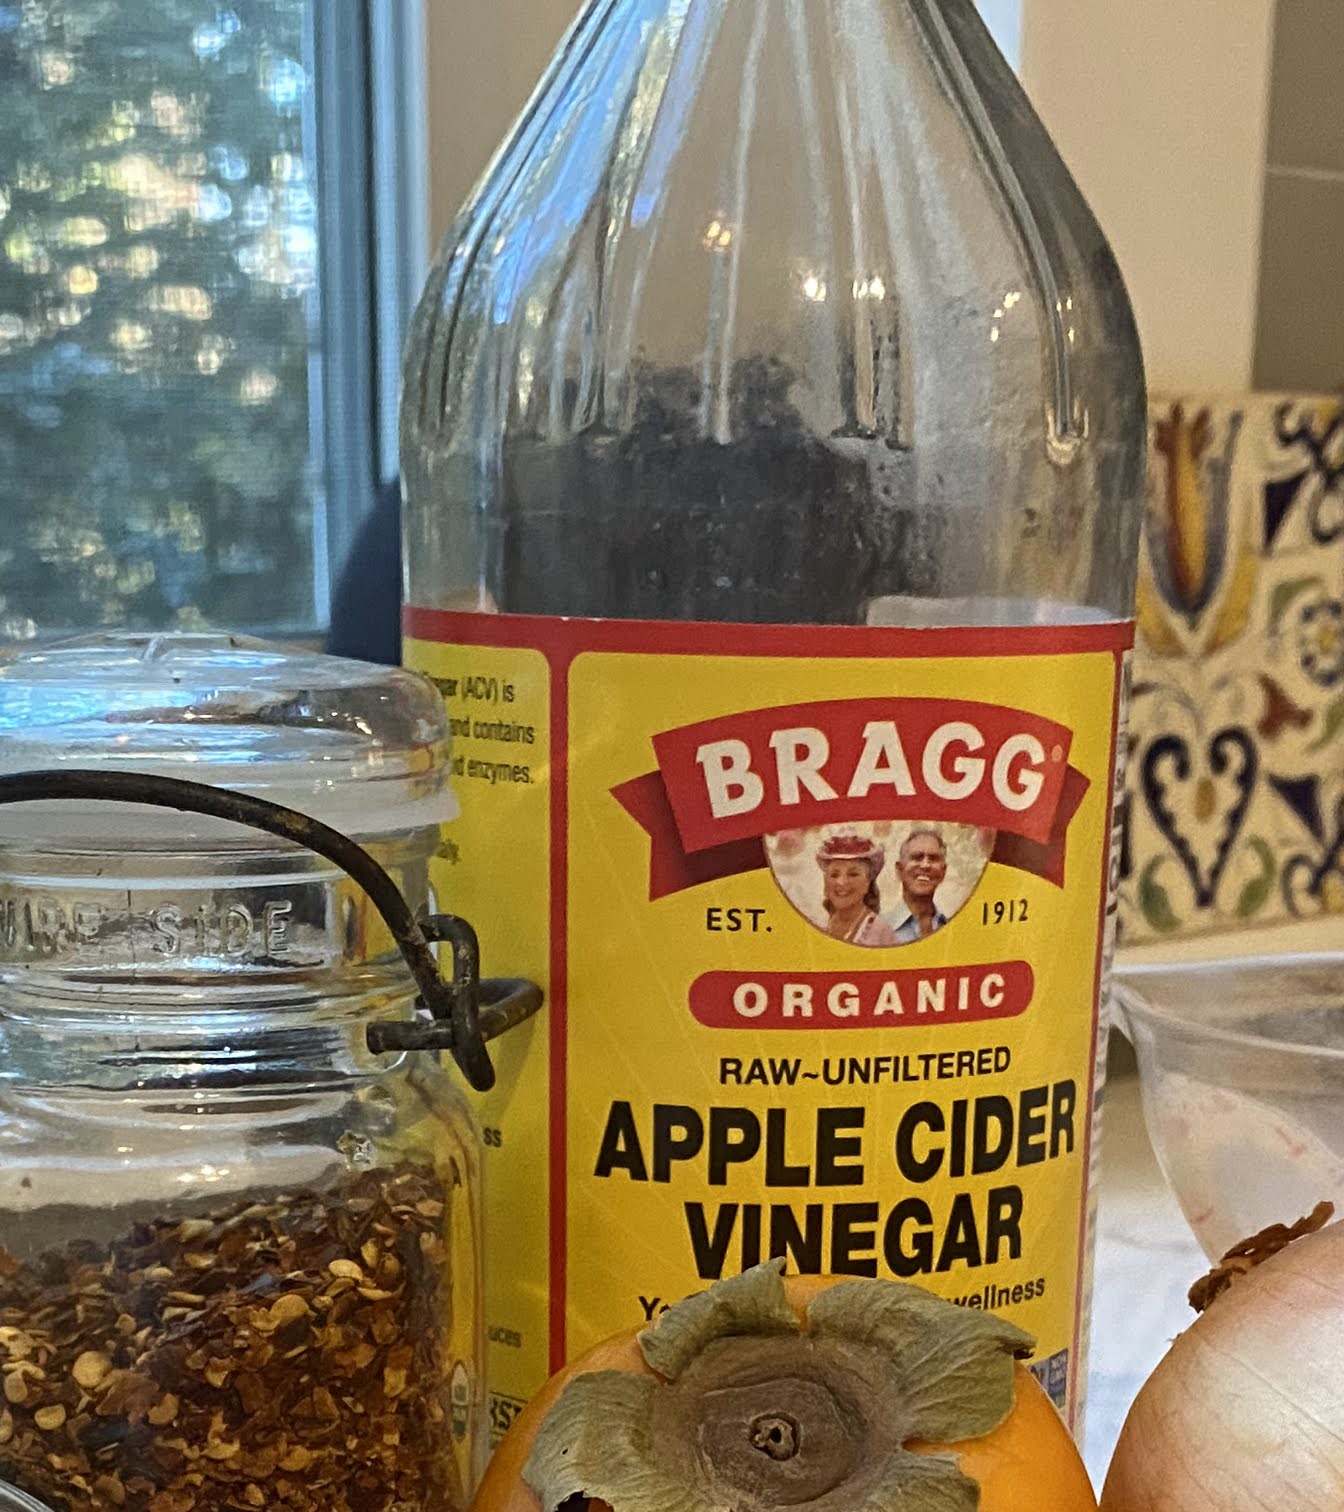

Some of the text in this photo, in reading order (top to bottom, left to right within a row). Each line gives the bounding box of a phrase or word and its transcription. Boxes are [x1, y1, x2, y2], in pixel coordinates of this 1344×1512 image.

[474, 719, 535, 744] contains
[468, 760, 534, 784] enzymes.
[696, 720, 1047, 820] BRAGG
[153, 900, 293, 956] SIDE
[706, 899, 1029, 933] EST. 1912
[733, 973, 1006, 1018] ORGANIC
[593, 1079, 1076, 1188] APPLE CIDER
[684, 1184, 1024, 1280] VINEGAR
